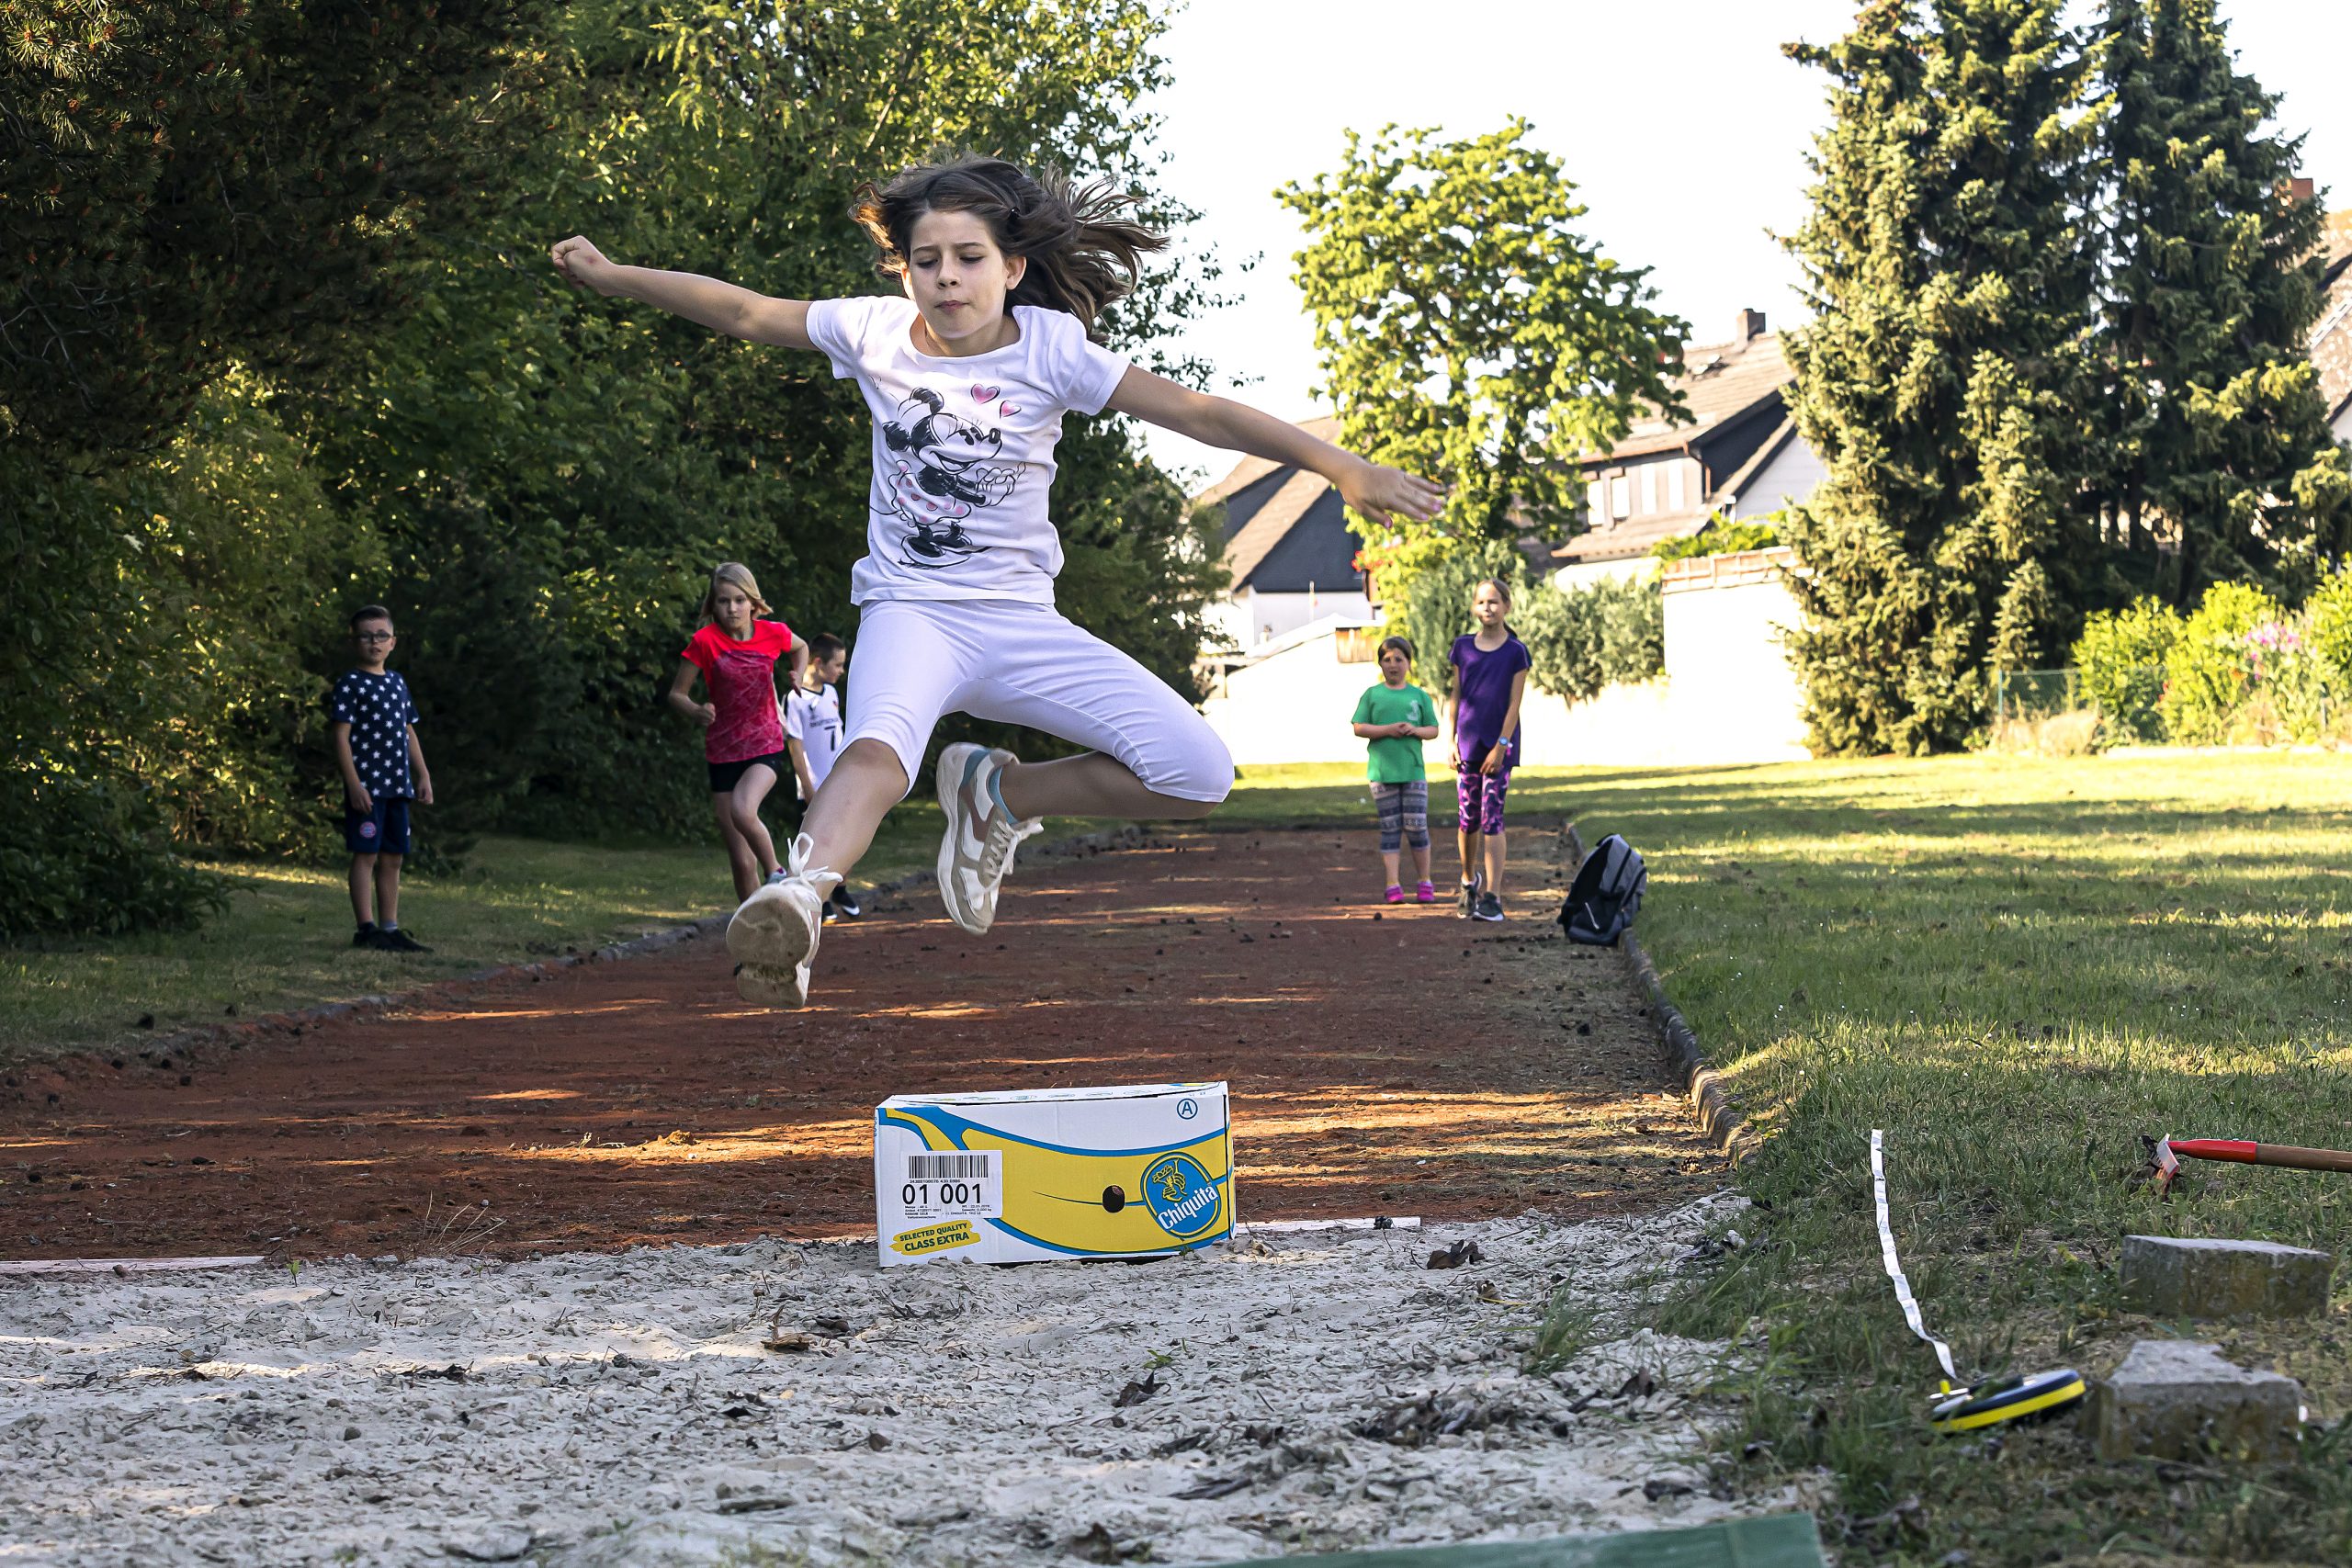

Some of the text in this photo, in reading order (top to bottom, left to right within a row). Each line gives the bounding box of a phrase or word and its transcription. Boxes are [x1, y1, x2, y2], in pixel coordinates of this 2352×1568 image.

[824, 726, 835, 751] 7
[1182, 1101, 1193, 1115] A
[902, 1183, 981, 1205] 01 001
[1158, 1186, 1218, 1229] Chiquita
[899, 1223, 967, 1242] SELECTED QUALITY
[904, 1232, 970, 1252] CLASS EXTRA
